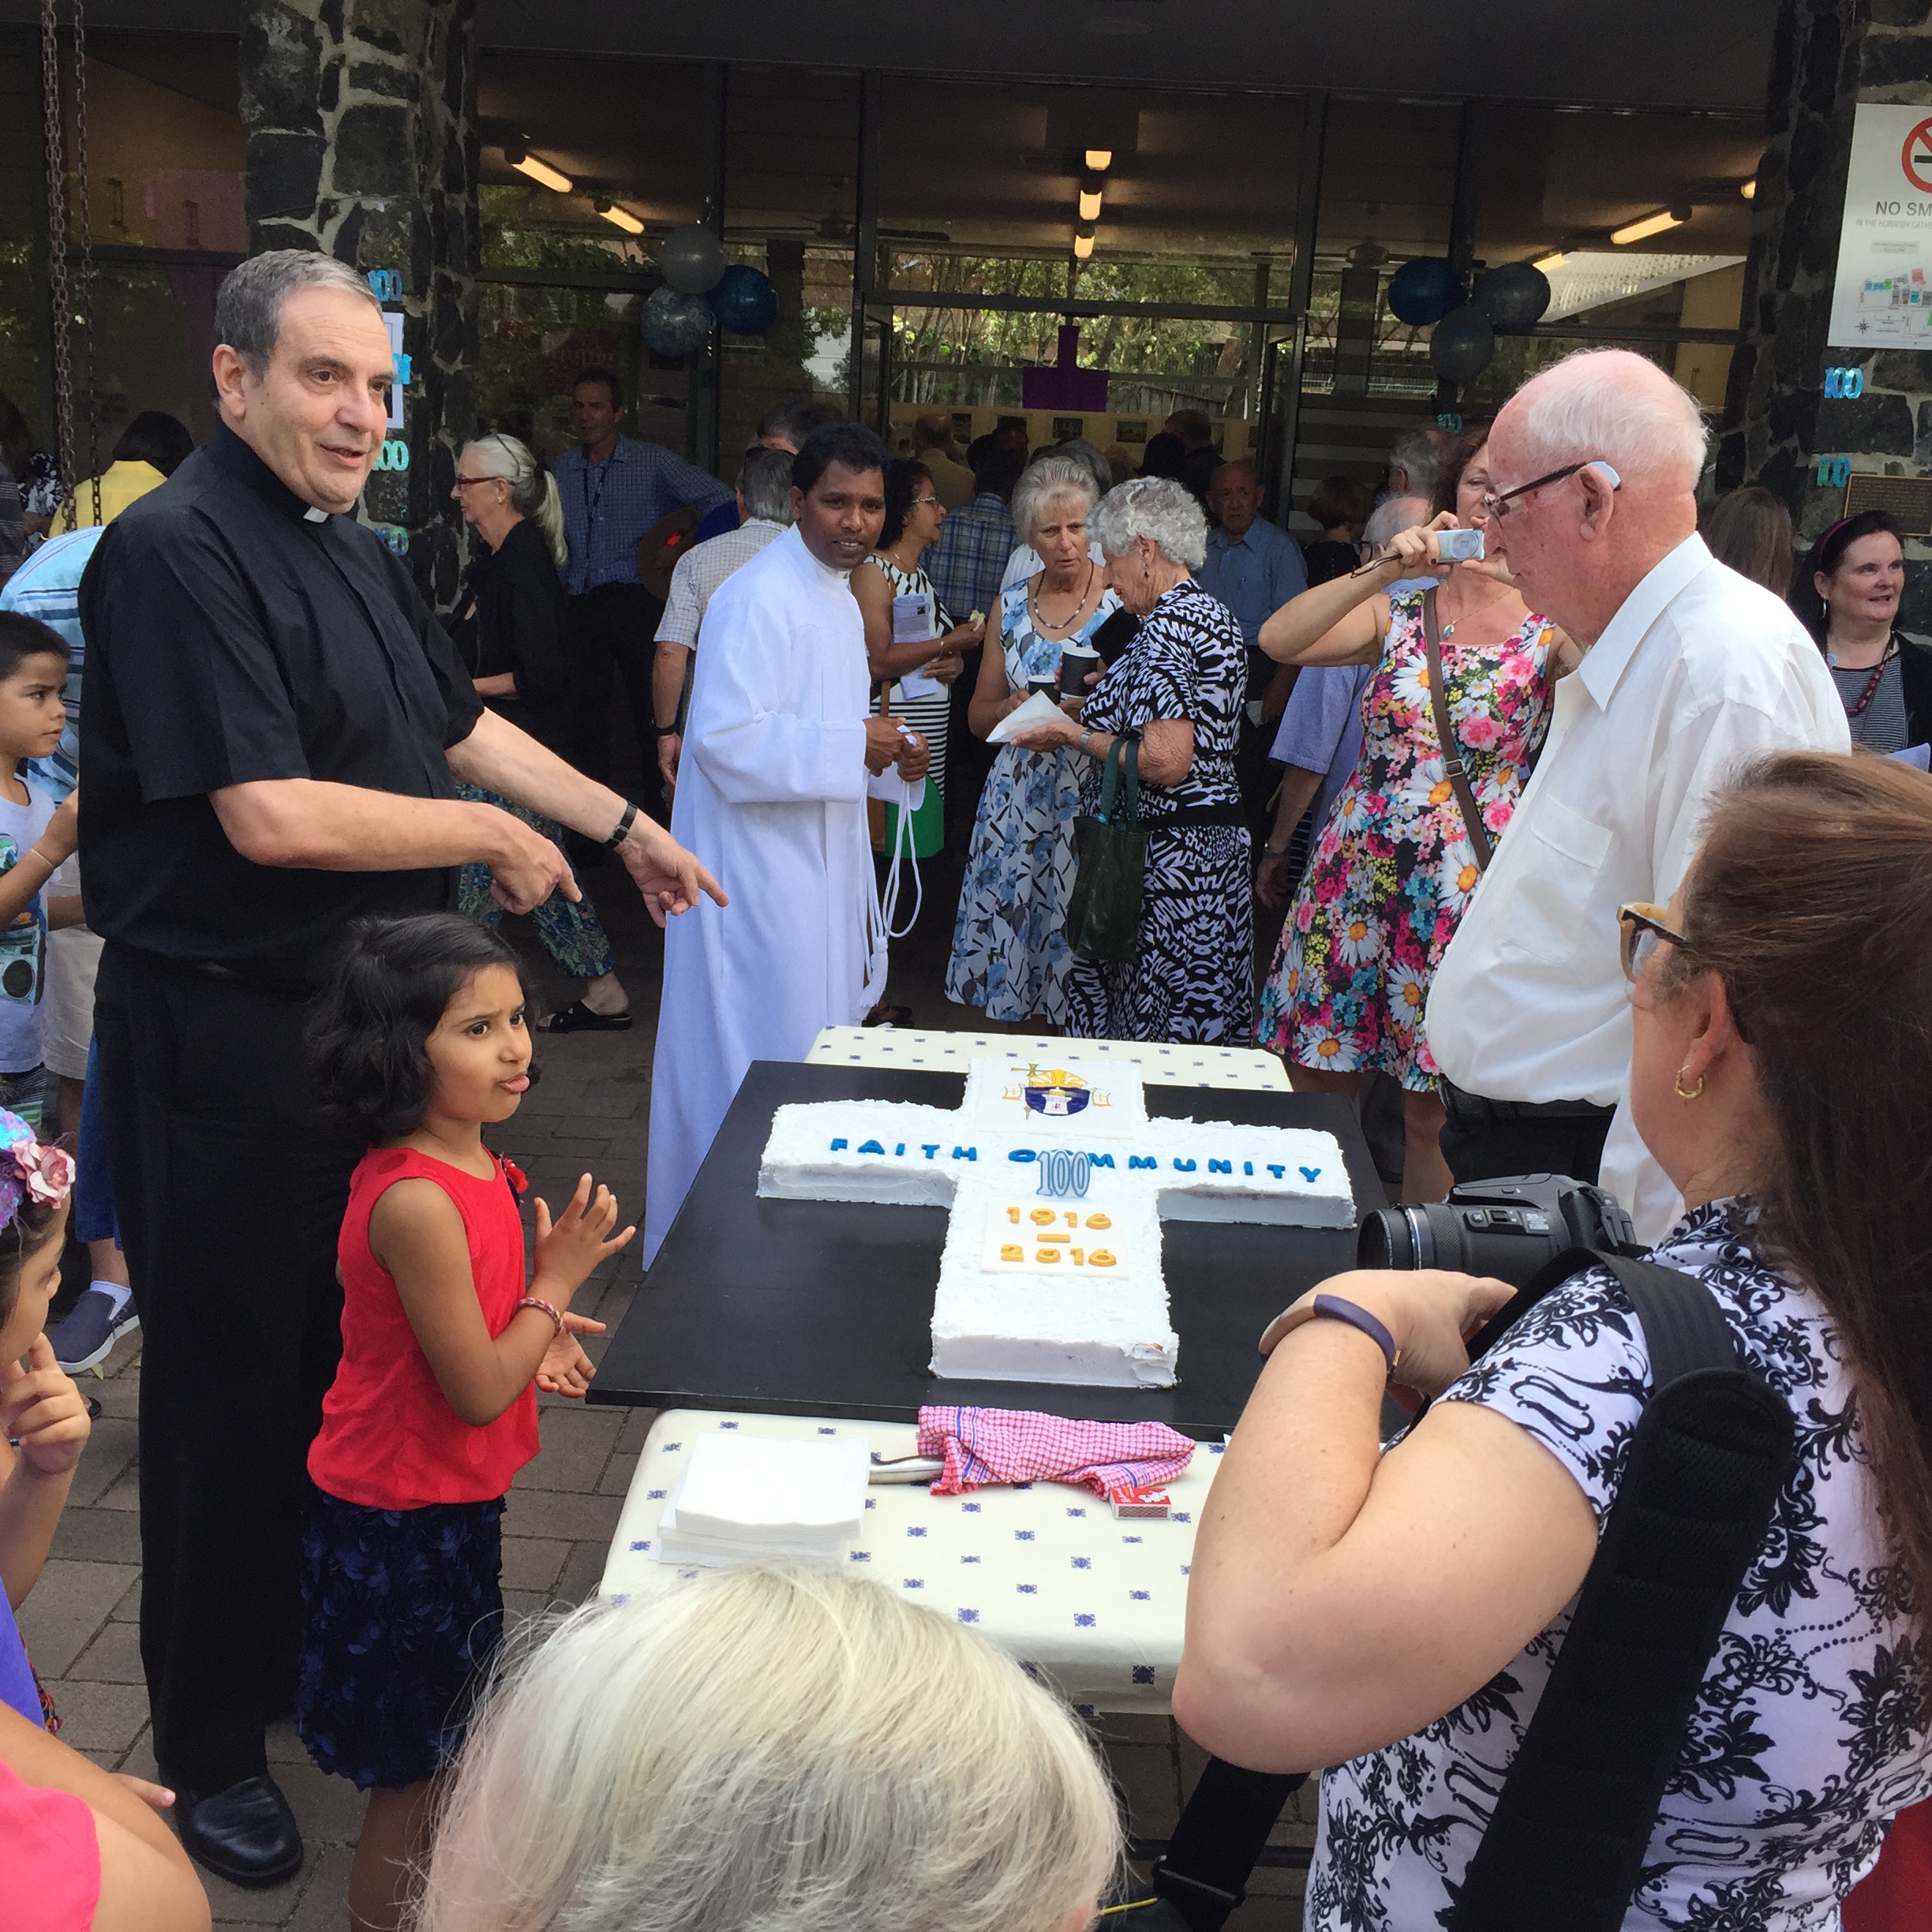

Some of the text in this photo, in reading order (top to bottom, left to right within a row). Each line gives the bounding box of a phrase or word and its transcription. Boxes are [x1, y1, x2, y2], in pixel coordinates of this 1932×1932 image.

[1875, 200, 1901, 215] NO
[1824, 367, 1864, 399] 100
[372, 440, 409, 471] 00
[830, 1138, 1322, 1183] FAITH CMMUNITY
[1036, 1150, 1091, 1198] 100
[1006, 1206, 1112, 1230] 1916
[1000, 1244, 1118, 1267] 2016
